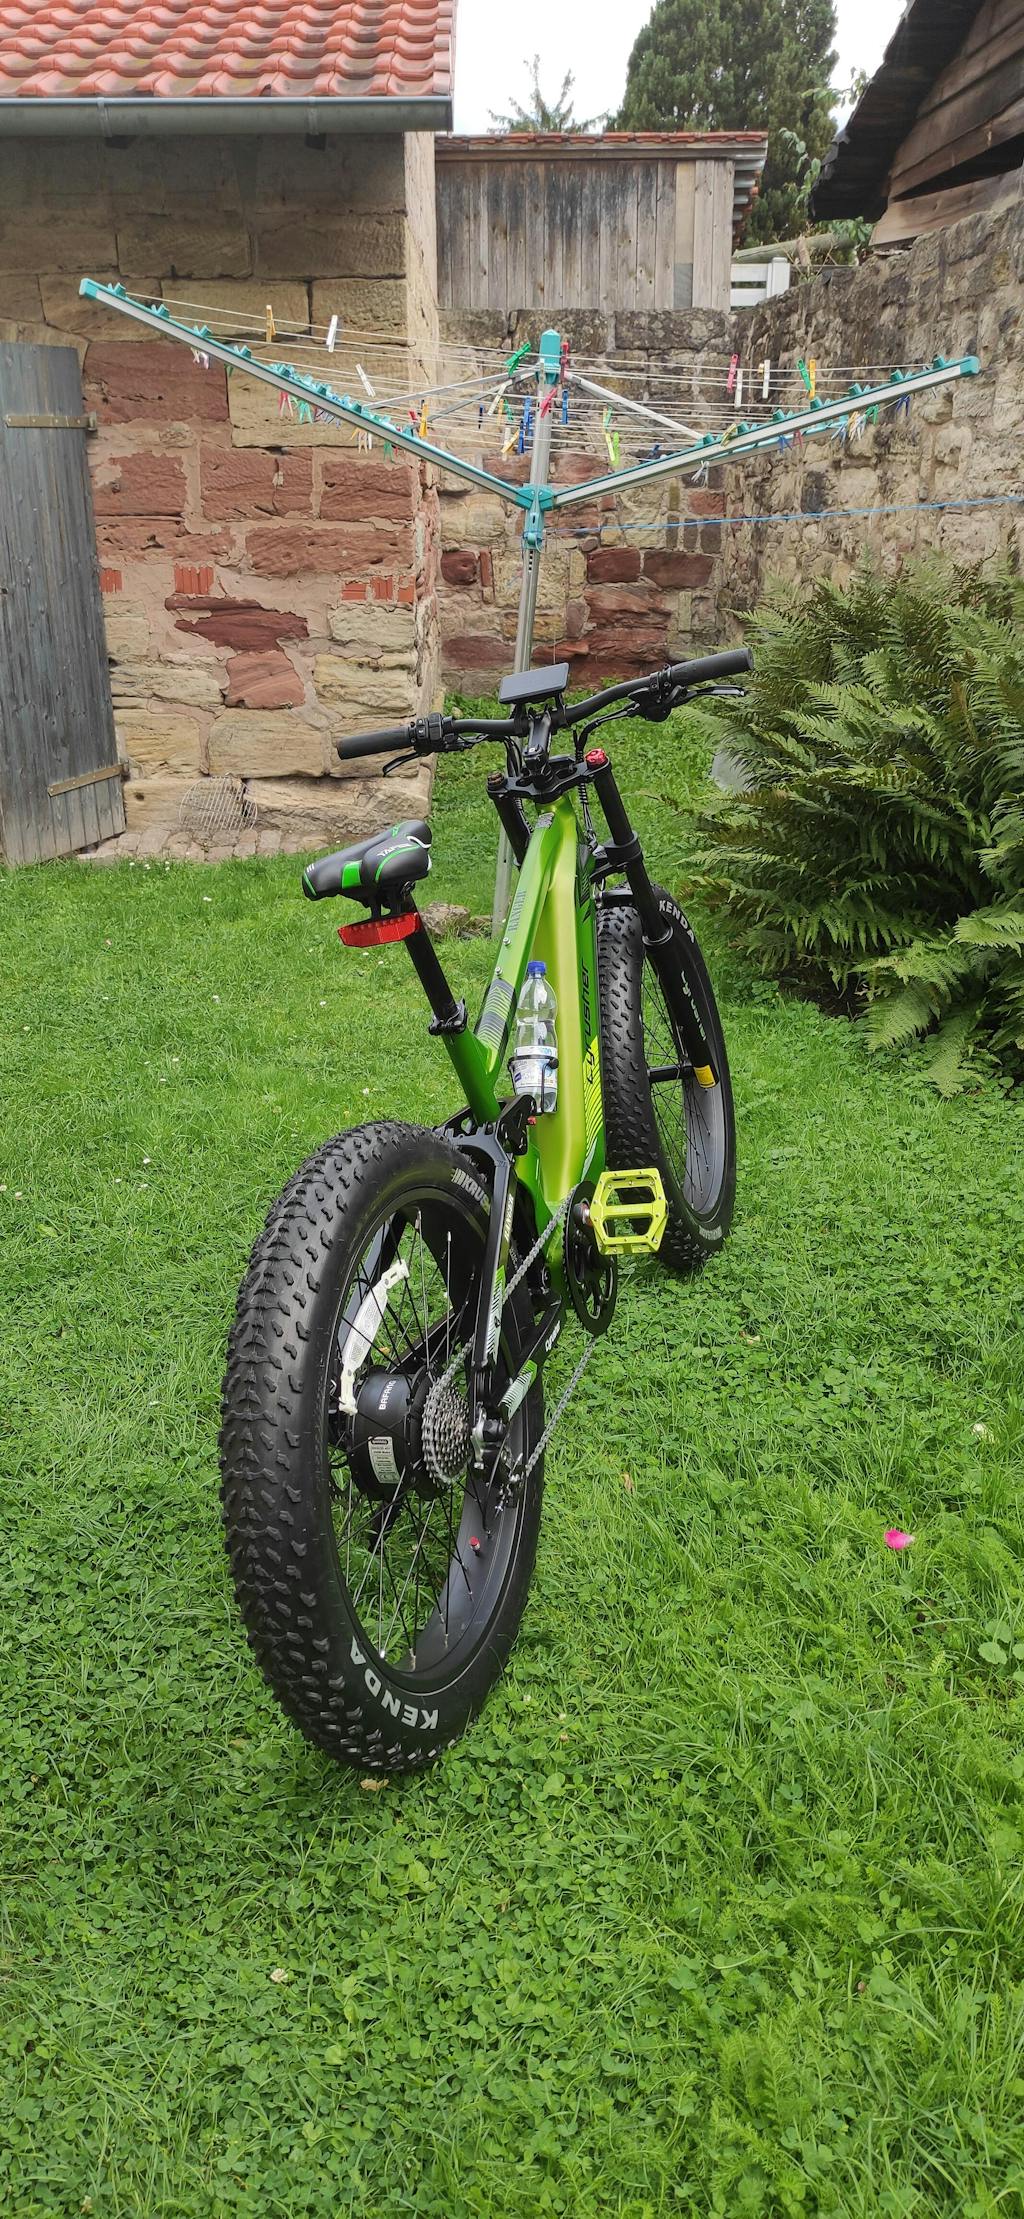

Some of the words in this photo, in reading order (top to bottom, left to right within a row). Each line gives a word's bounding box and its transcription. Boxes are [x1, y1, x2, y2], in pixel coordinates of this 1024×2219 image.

[659, 899, 695, 944] KENDA
[378, 1380, 397, 1410] BAFANG
[350, 1635, 439, 1730] KENDA
